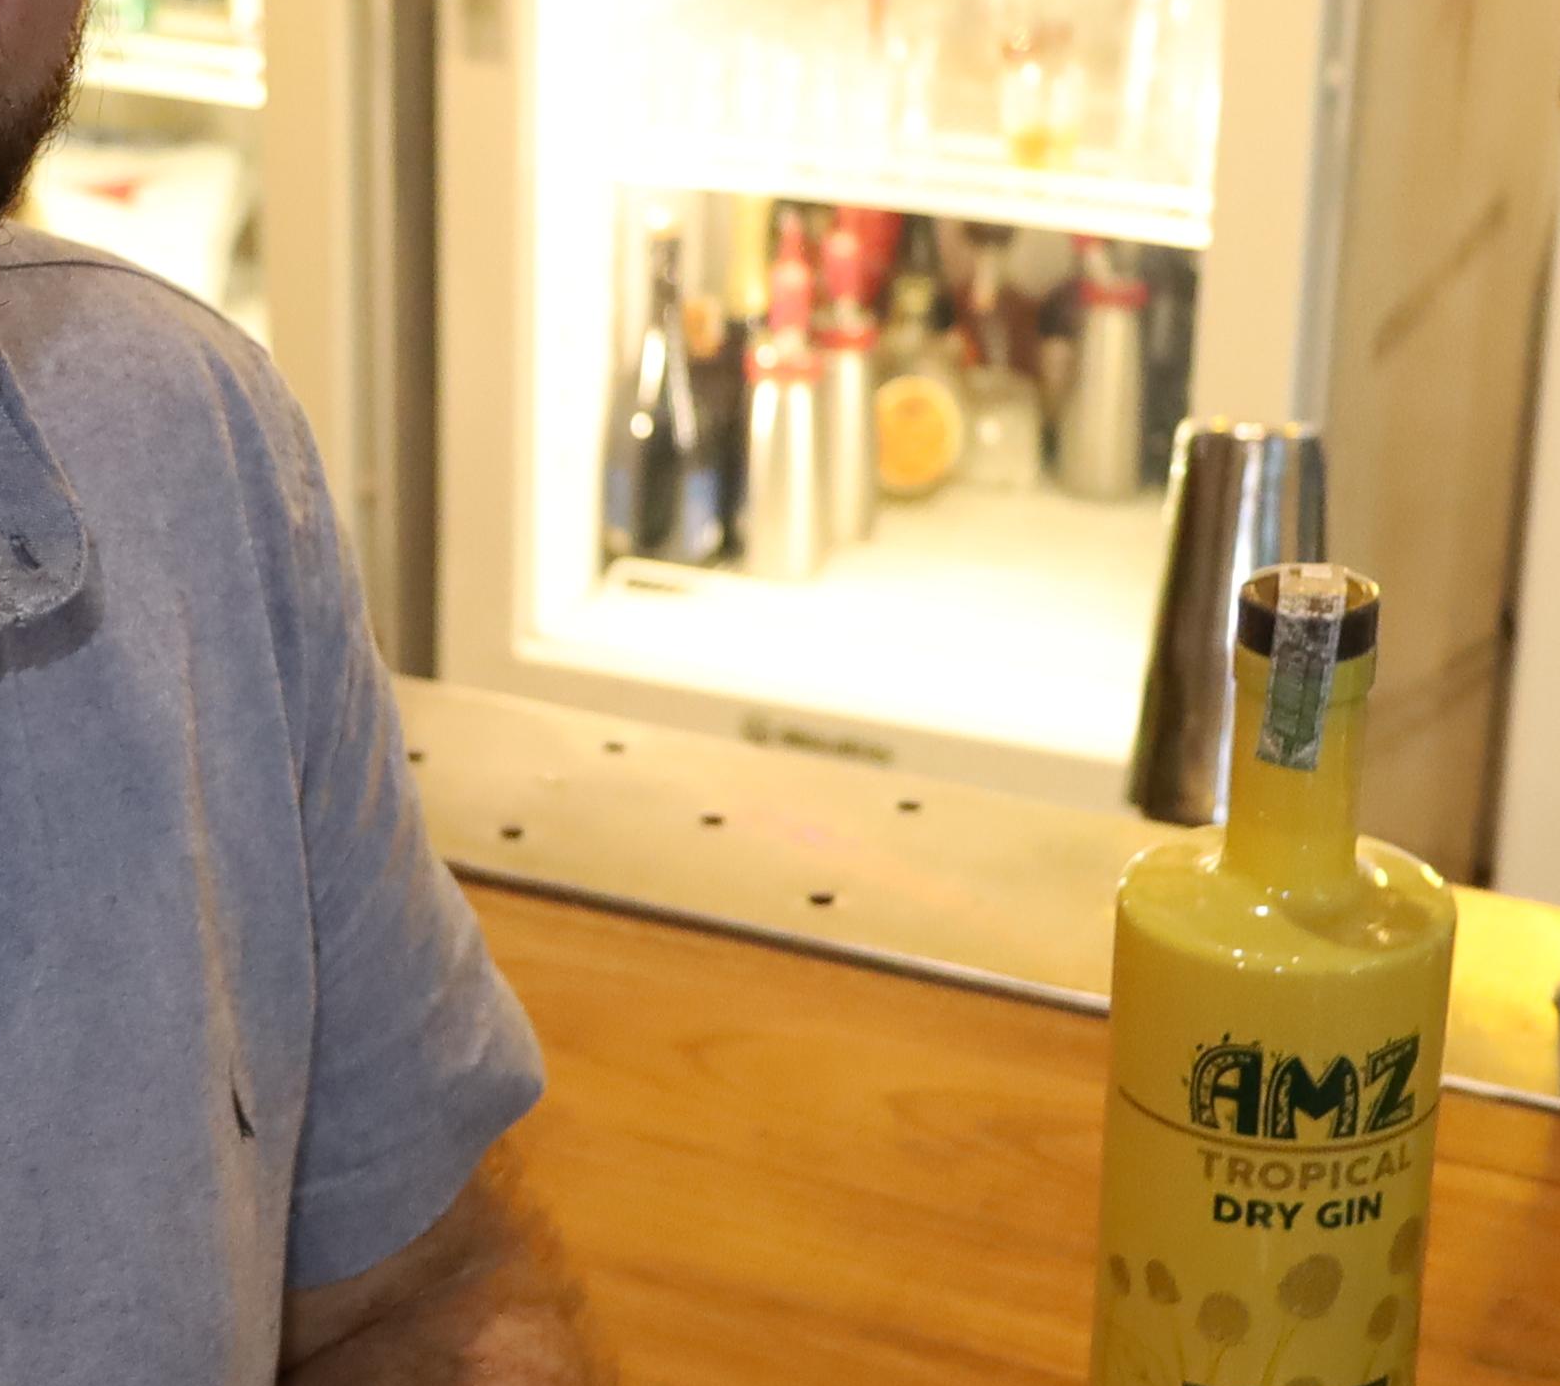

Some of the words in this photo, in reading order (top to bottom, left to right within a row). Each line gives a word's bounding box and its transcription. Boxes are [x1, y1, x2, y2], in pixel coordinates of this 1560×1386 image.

[1189, 1033, 1421, 1140] AMZ
[1197, 1144, 1413, 1192] TROPICAL
[1213, 1192, 1304, 1231] DRY
[1315, 1191, 1383, 1229] GIN
